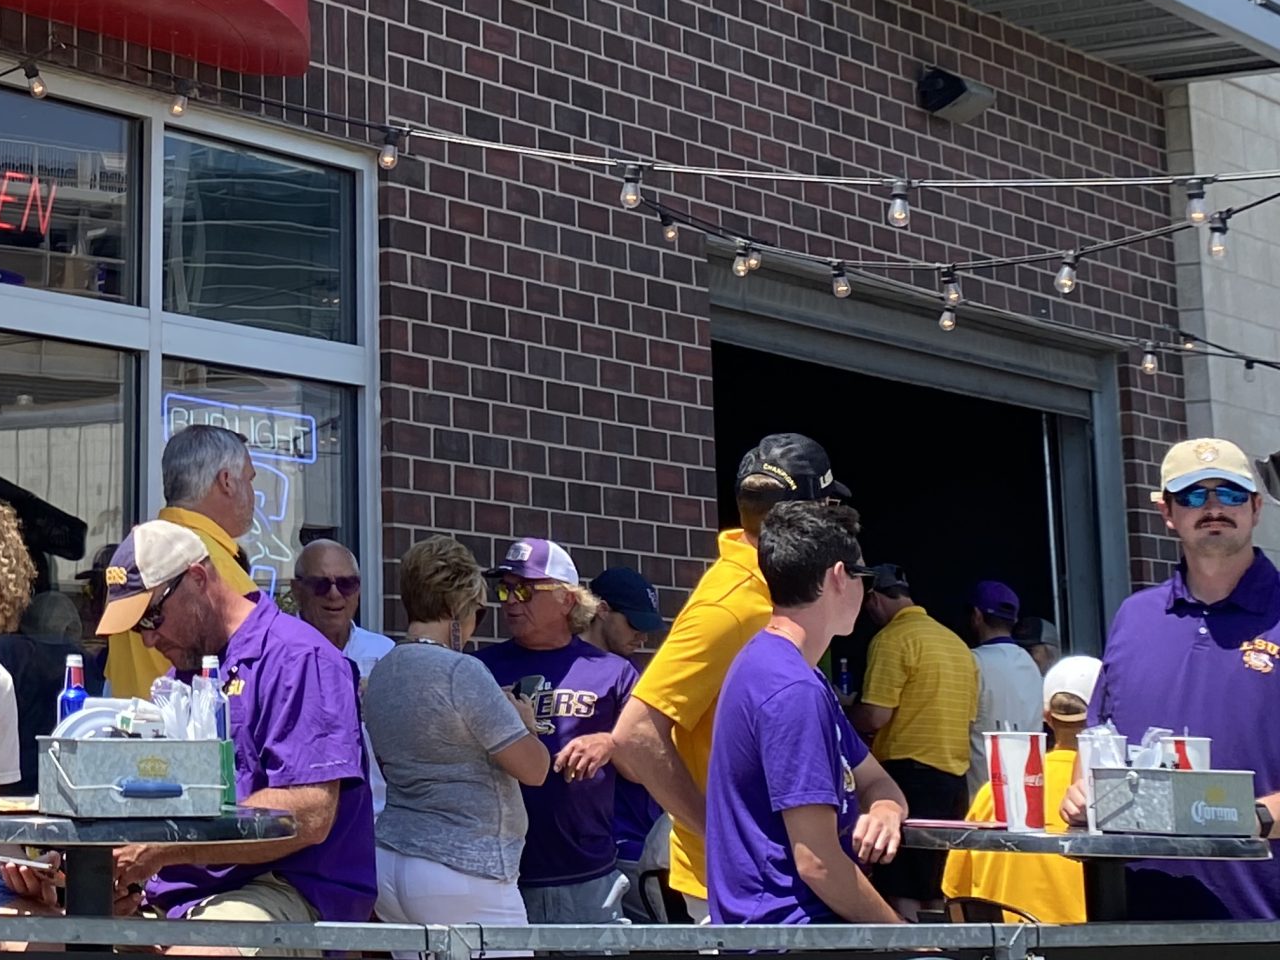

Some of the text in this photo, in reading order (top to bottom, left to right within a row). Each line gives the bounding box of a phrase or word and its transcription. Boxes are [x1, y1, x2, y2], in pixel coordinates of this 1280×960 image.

[1240, 638, 1280, 656] LSU
[531, 689, 598, 718] ERS
[1191, 800, 1238, 826] Corona
